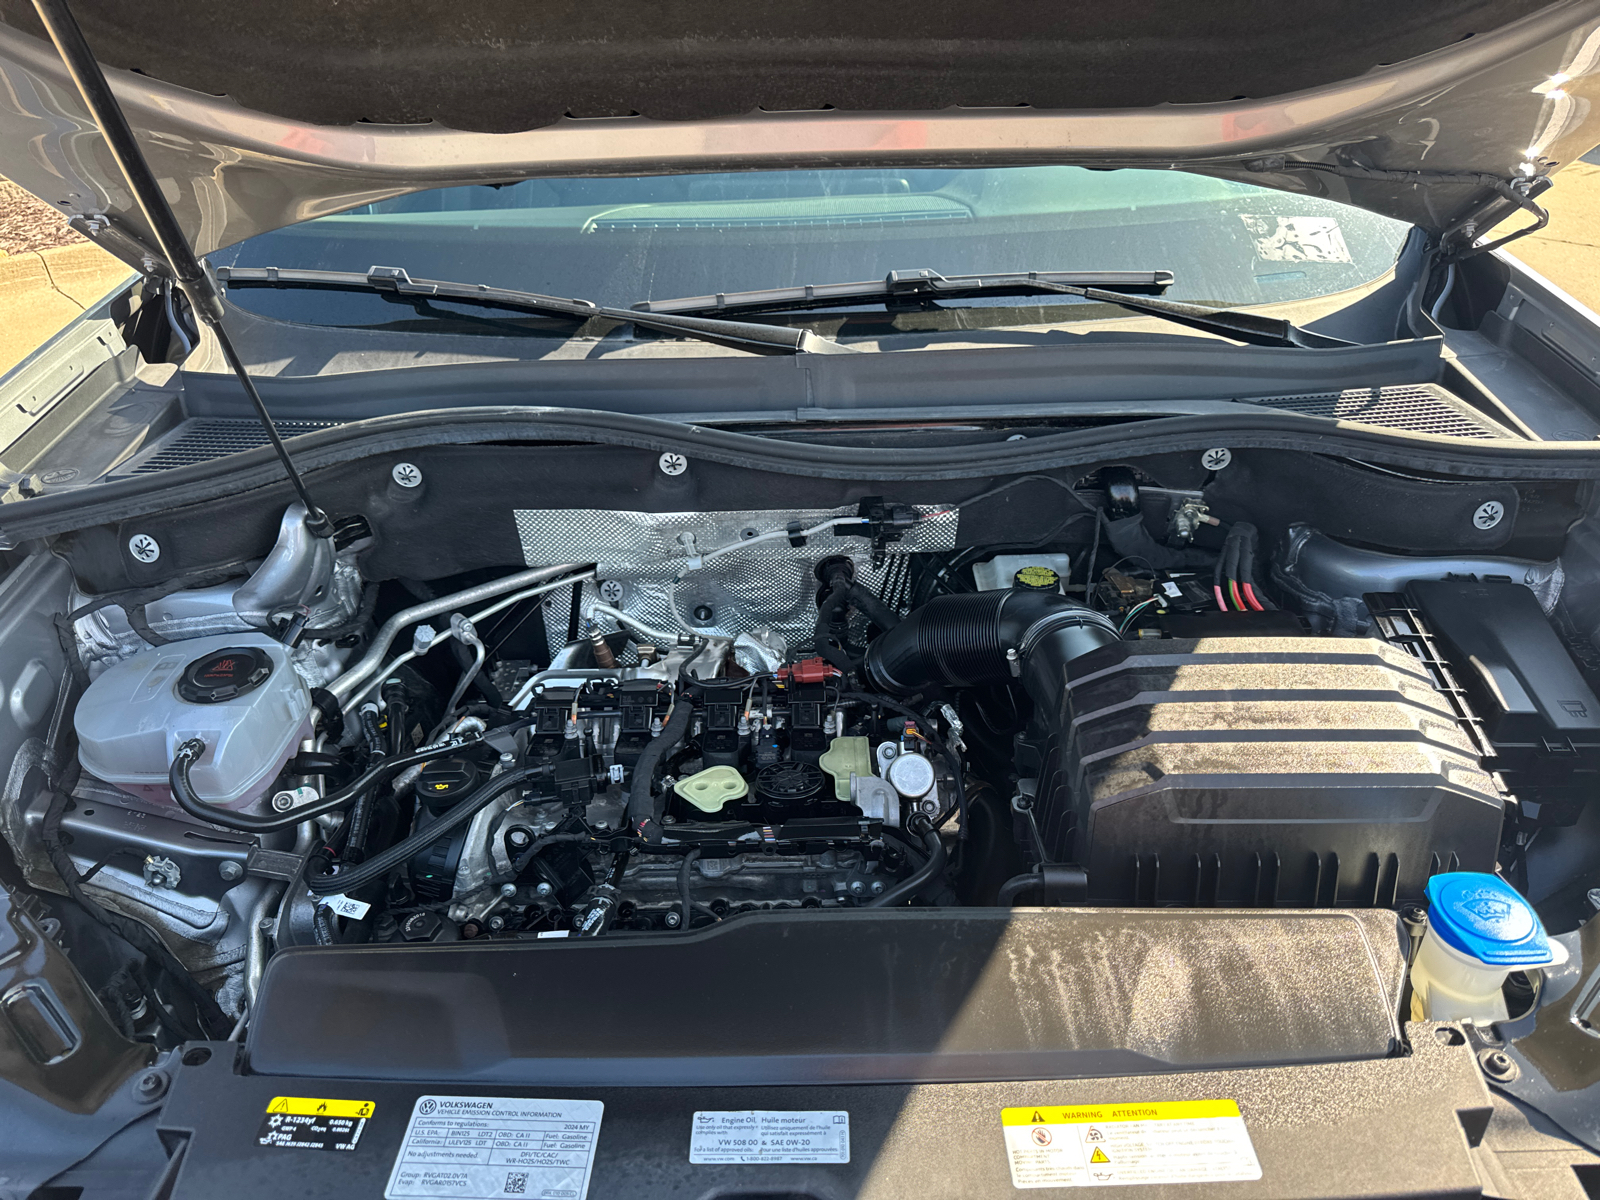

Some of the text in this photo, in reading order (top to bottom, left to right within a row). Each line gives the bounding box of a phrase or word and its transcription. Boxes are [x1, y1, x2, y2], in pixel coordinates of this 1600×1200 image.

[440, 1101, 493, 1109] VOLKSWAGEN
[1062, 1108, 1158, 1120] WARNING ATTENTION
[285, 1116, 316, 1125] R-1234yf
[454, 1120, 490, 1128] regulations:
[722, 1117, 744, 1125] Engine
[417, 1151, 454, 1159] adjustments
[400, 1171, 421, 1179] Group:
